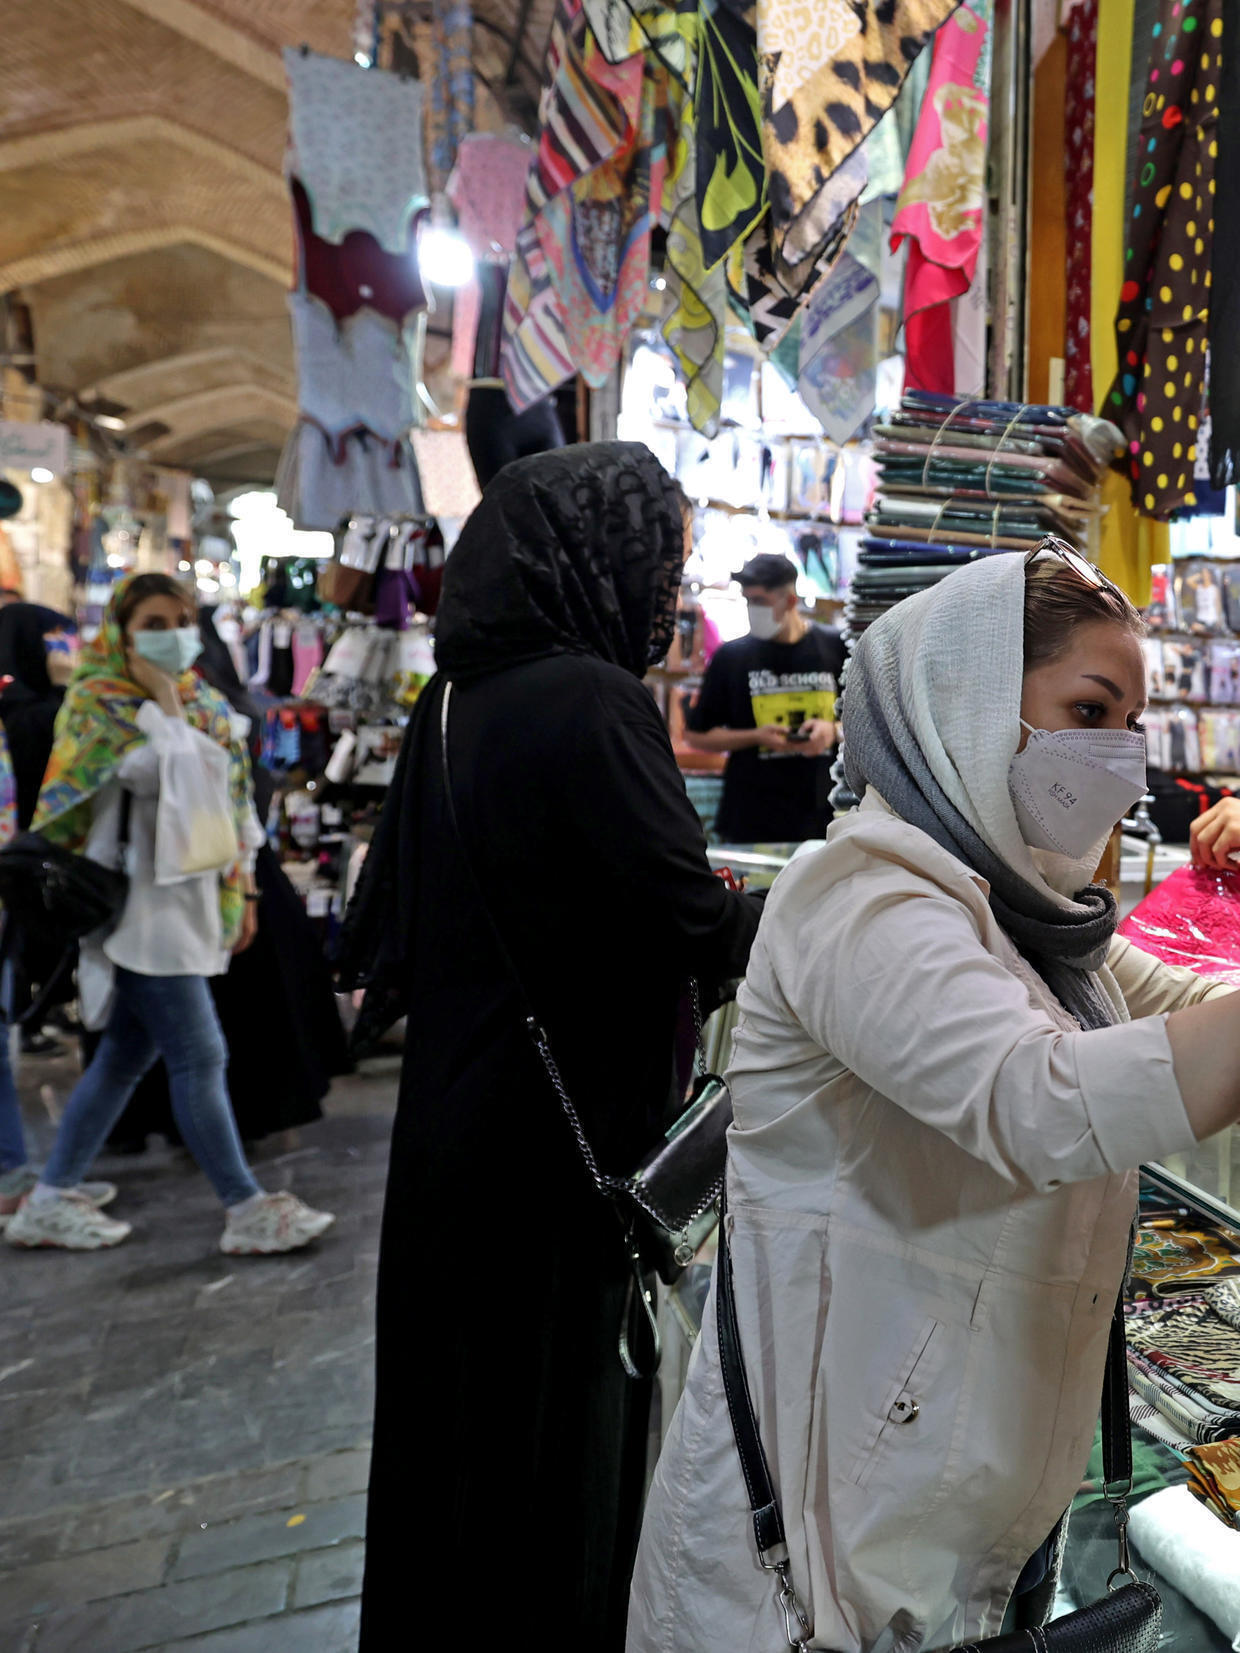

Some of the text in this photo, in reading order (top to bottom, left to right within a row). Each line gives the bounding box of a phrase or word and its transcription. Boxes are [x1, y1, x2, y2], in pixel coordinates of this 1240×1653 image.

[780, 673, 833, 686] SCHOOL
[1051, 782, 1066, 793] KF
[1064, 792, 1077, 805] 94
